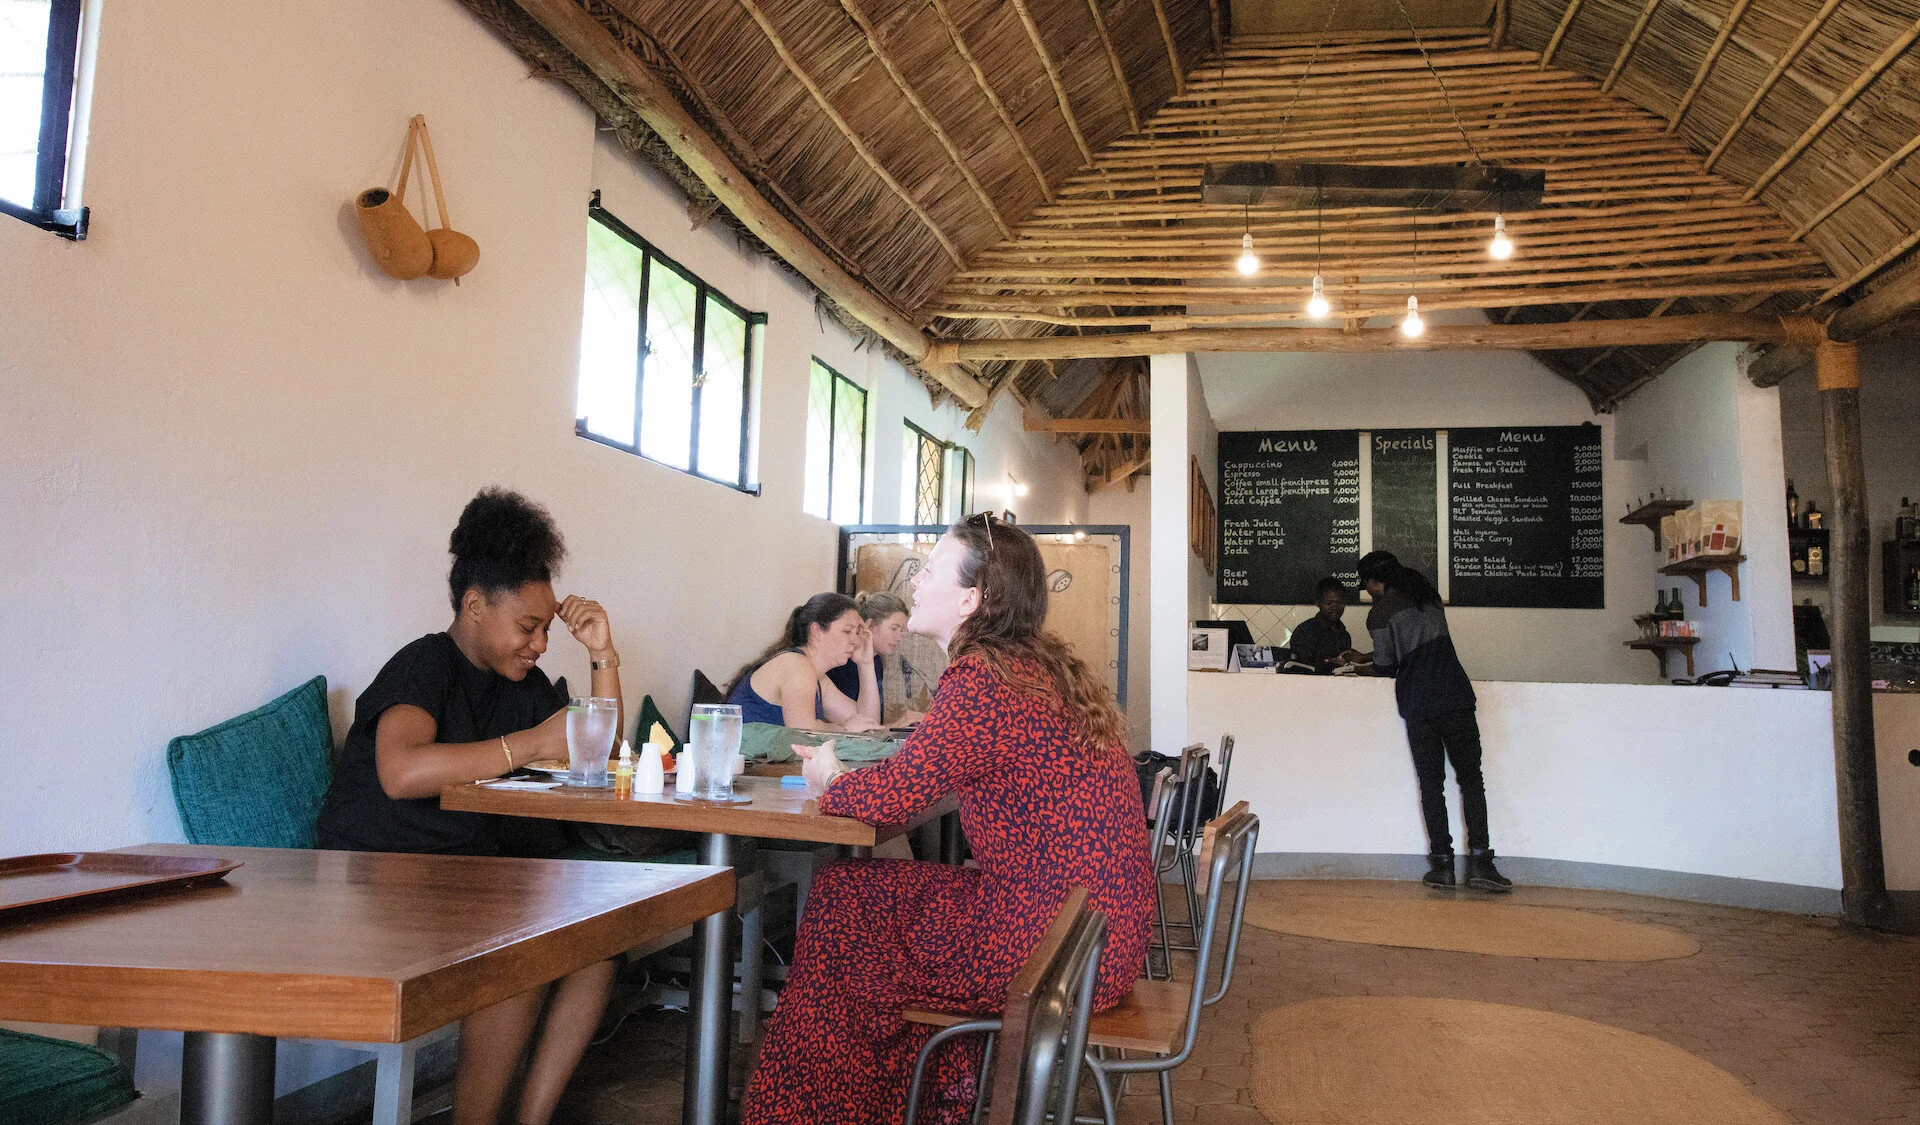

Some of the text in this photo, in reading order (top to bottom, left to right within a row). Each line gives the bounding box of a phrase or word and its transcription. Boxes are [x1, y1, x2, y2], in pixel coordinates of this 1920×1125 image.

[1500, 431, 1545, 443] Menu
[1258, 438, 1318, 453] Menu
[1375, 435, 1434, 455] Specials
[1452, 446, 1483, 456] Muffin
[1496, 445, 1519, 453] Cake
[1224, 460, 1282, 471] Cappuccino
[1496, 459, 1527, 468] Chapati
[1224, 470, 1260, 480] Espresso
[1224, 480, 1253, 489] Coffee
[1256, 478, 1279, 486] small
[1280, 477, 1329, 489] frenchpress
[1475, 482, 1513, 491] Breakfast
[1224, 488, 1253, 498] Coffee
[1256, 487, 1278, 496] large
[1280, 486, 1330, 498] frenchpress
[1225, 497, 1245, 505] Iced
[1249, 496, 1282, 506] Coffee
[1453, 495, 1483, 503] Grilled
[1224, 519, 1250, 527] Fresh
[1253, 519, 1280, 527] Juice
[1224, 529, 1254, 537] Water
[1257, 528, 1286, 536] small
[1224, 538, 1254, 546] Water
[1258, 537, 1285, 549] large
[1489, 536, 1513, 545] Curry
[1224, 546, 1250, 555] Soda
[1484, 562, 1507, 570] Salad
[1223, 568, 1248, 577] Beer
[1455, 569, 1481, 577] Sesame
[1223, 578, 1250, 587] Wine
